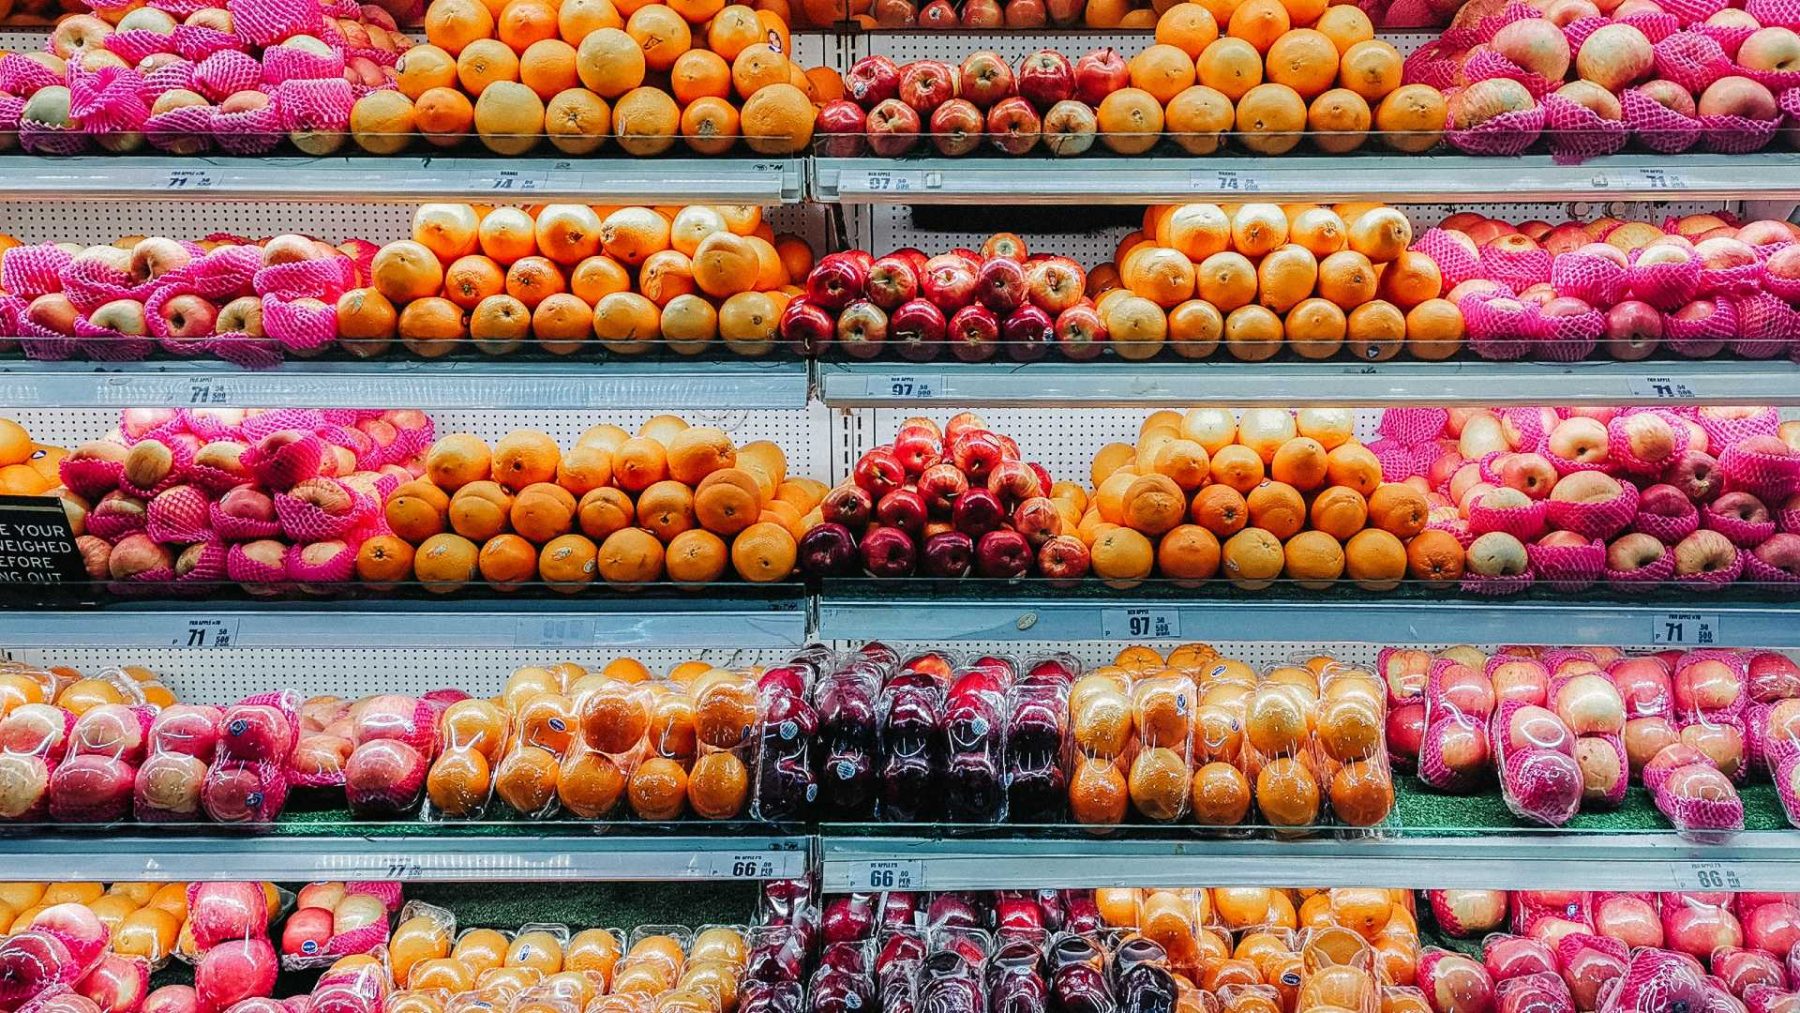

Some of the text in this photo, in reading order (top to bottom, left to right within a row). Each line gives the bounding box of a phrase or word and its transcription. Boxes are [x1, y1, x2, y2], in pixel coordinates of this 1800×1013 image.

[190, 385, 210, 403] 71
[891, 383, 913, 396] 97
[1652, 384, 1675, 398] 71
[14, 525, 66, 538] YOUR
[27, 572, 62, 585] OUT
[1129, 617, 1150, 636] 97
[1665, 622, 1683, 642] 71
[187, 628, 206, 647] 71
[215, 635, 230, 643] 500
[1699, 631, 1713, 640] 500
[732, 861, 757, 877] 66
[870, 869, 894, 887] 66
[1697, 870, 1724, 888] 86
